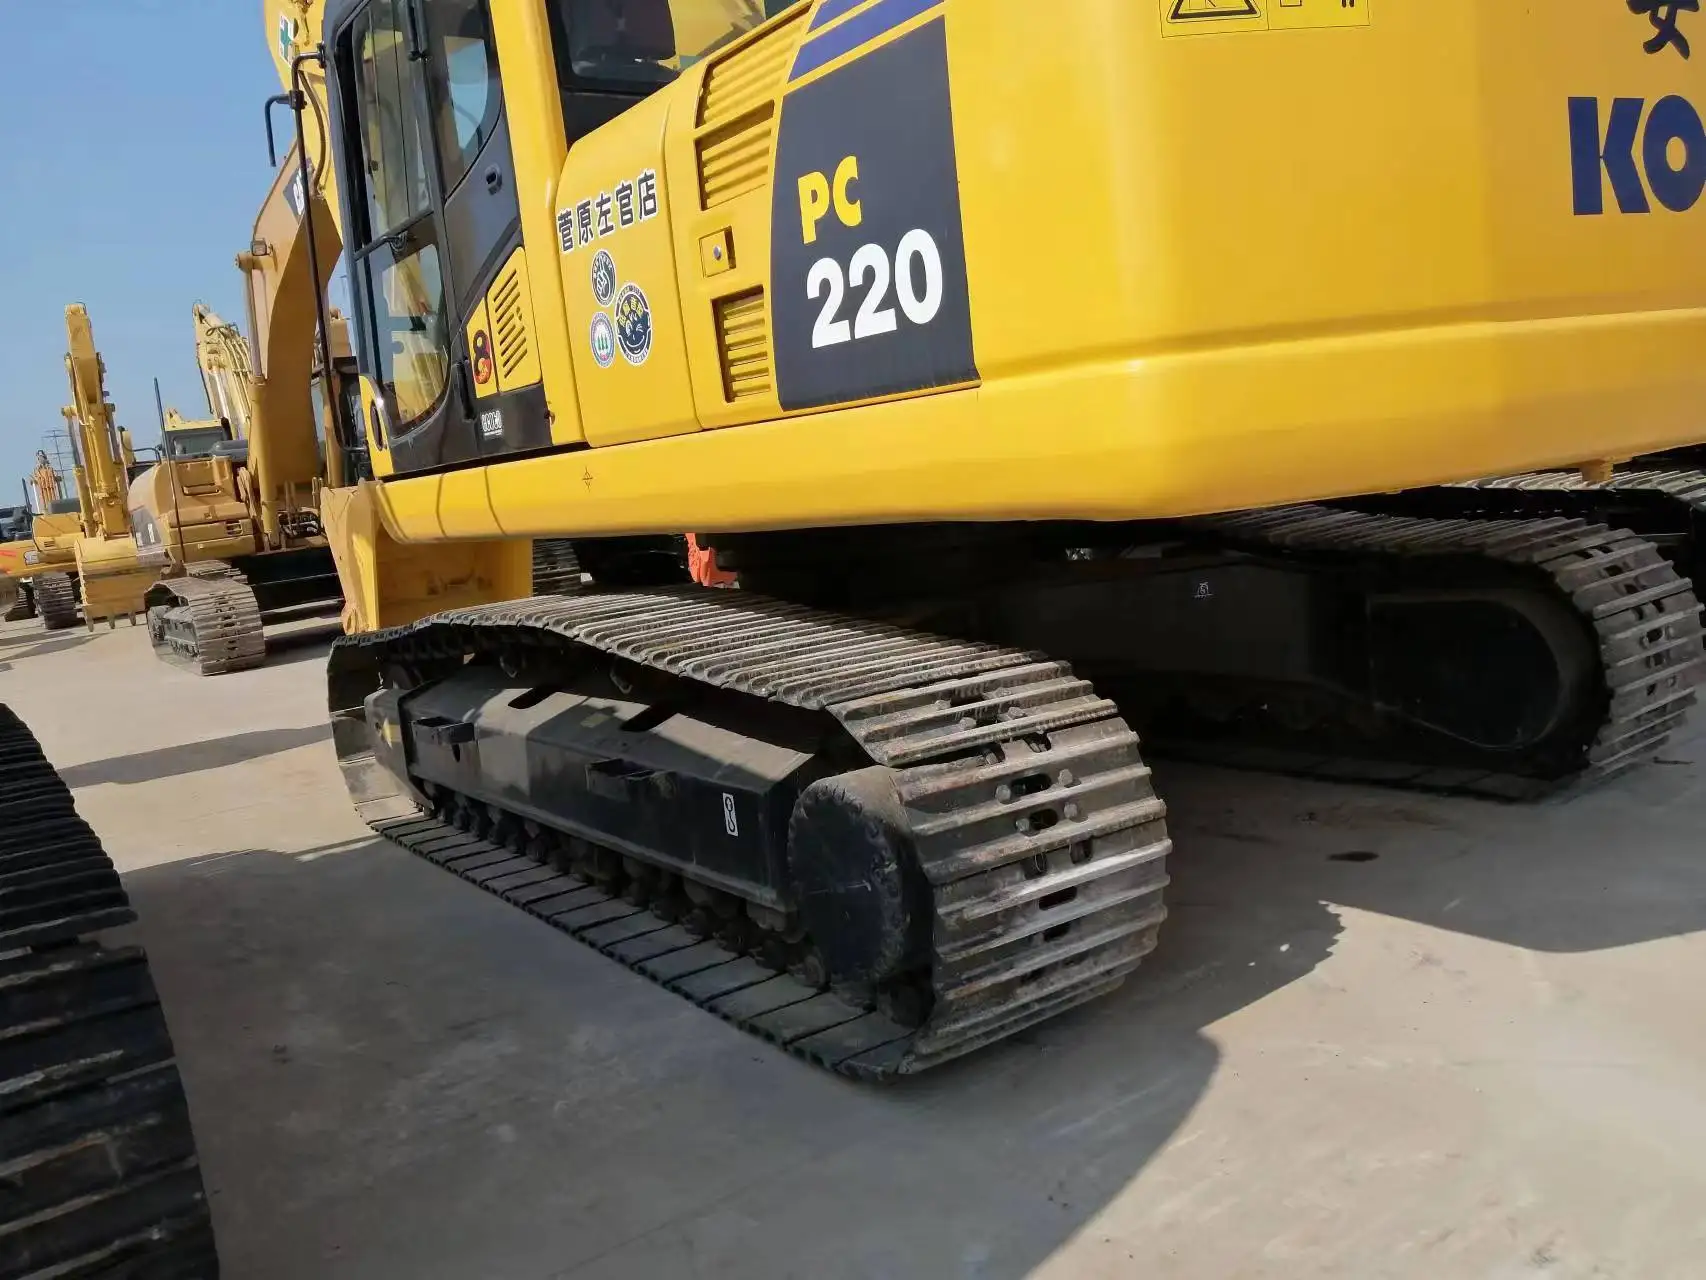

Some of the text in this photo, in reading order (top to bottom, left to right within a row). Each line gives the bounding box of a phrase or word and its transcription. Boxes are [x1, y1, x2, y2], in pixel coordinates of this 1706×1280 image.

[798, 155, 862, 245] PC
[1567, 94, 1706, 216] KO
[557, 169, 658, 251] 菅原左官店
[806, 228, 943, 349] 220
